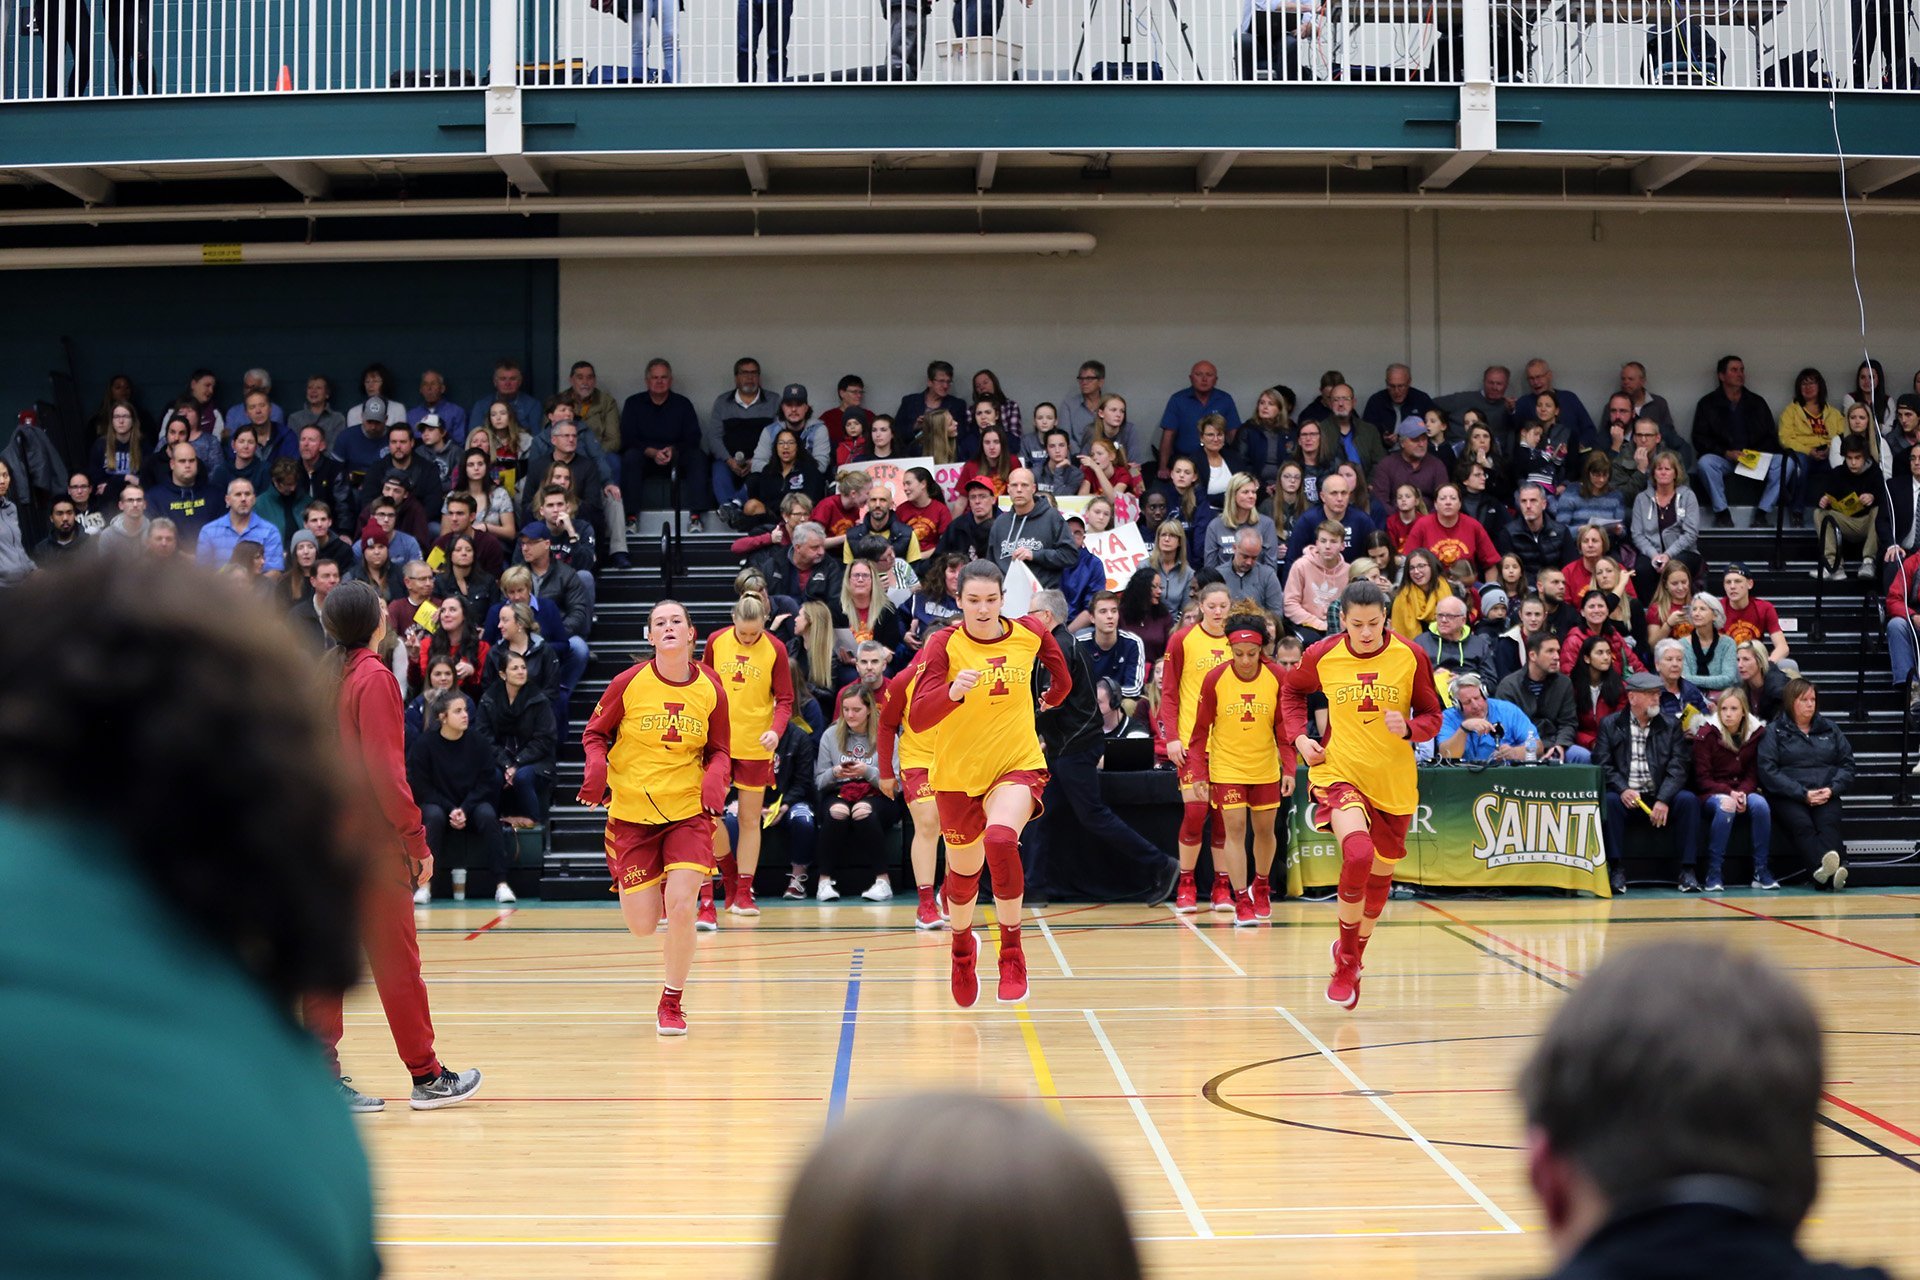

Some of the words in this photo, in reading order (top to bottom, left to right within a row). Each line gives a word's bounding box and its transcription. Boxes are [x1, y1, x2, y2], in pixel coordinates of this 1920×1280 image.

[868, 463, 899, 481] ET'S
[1091, 533, 1127, 555] WA
[1104, 553, 1145, 574] ATE
[720, 660, 761, 681] STATE
[972, 666, 1027, 689] TATE
[1336, 683, 1399, 705] STATE
[1226, 701, 1270, 716] STATE
[640, 714, 703, 736] STATE
[1493, 784, 1510, 795] ST.
[1514, 789, 1547, 799] CLAIR
[1550, 790, 1600, 799] COLLEGE
[1493, 852, 1590, 870] ATHLETICS
[623, 869, 648, 884] STATE
